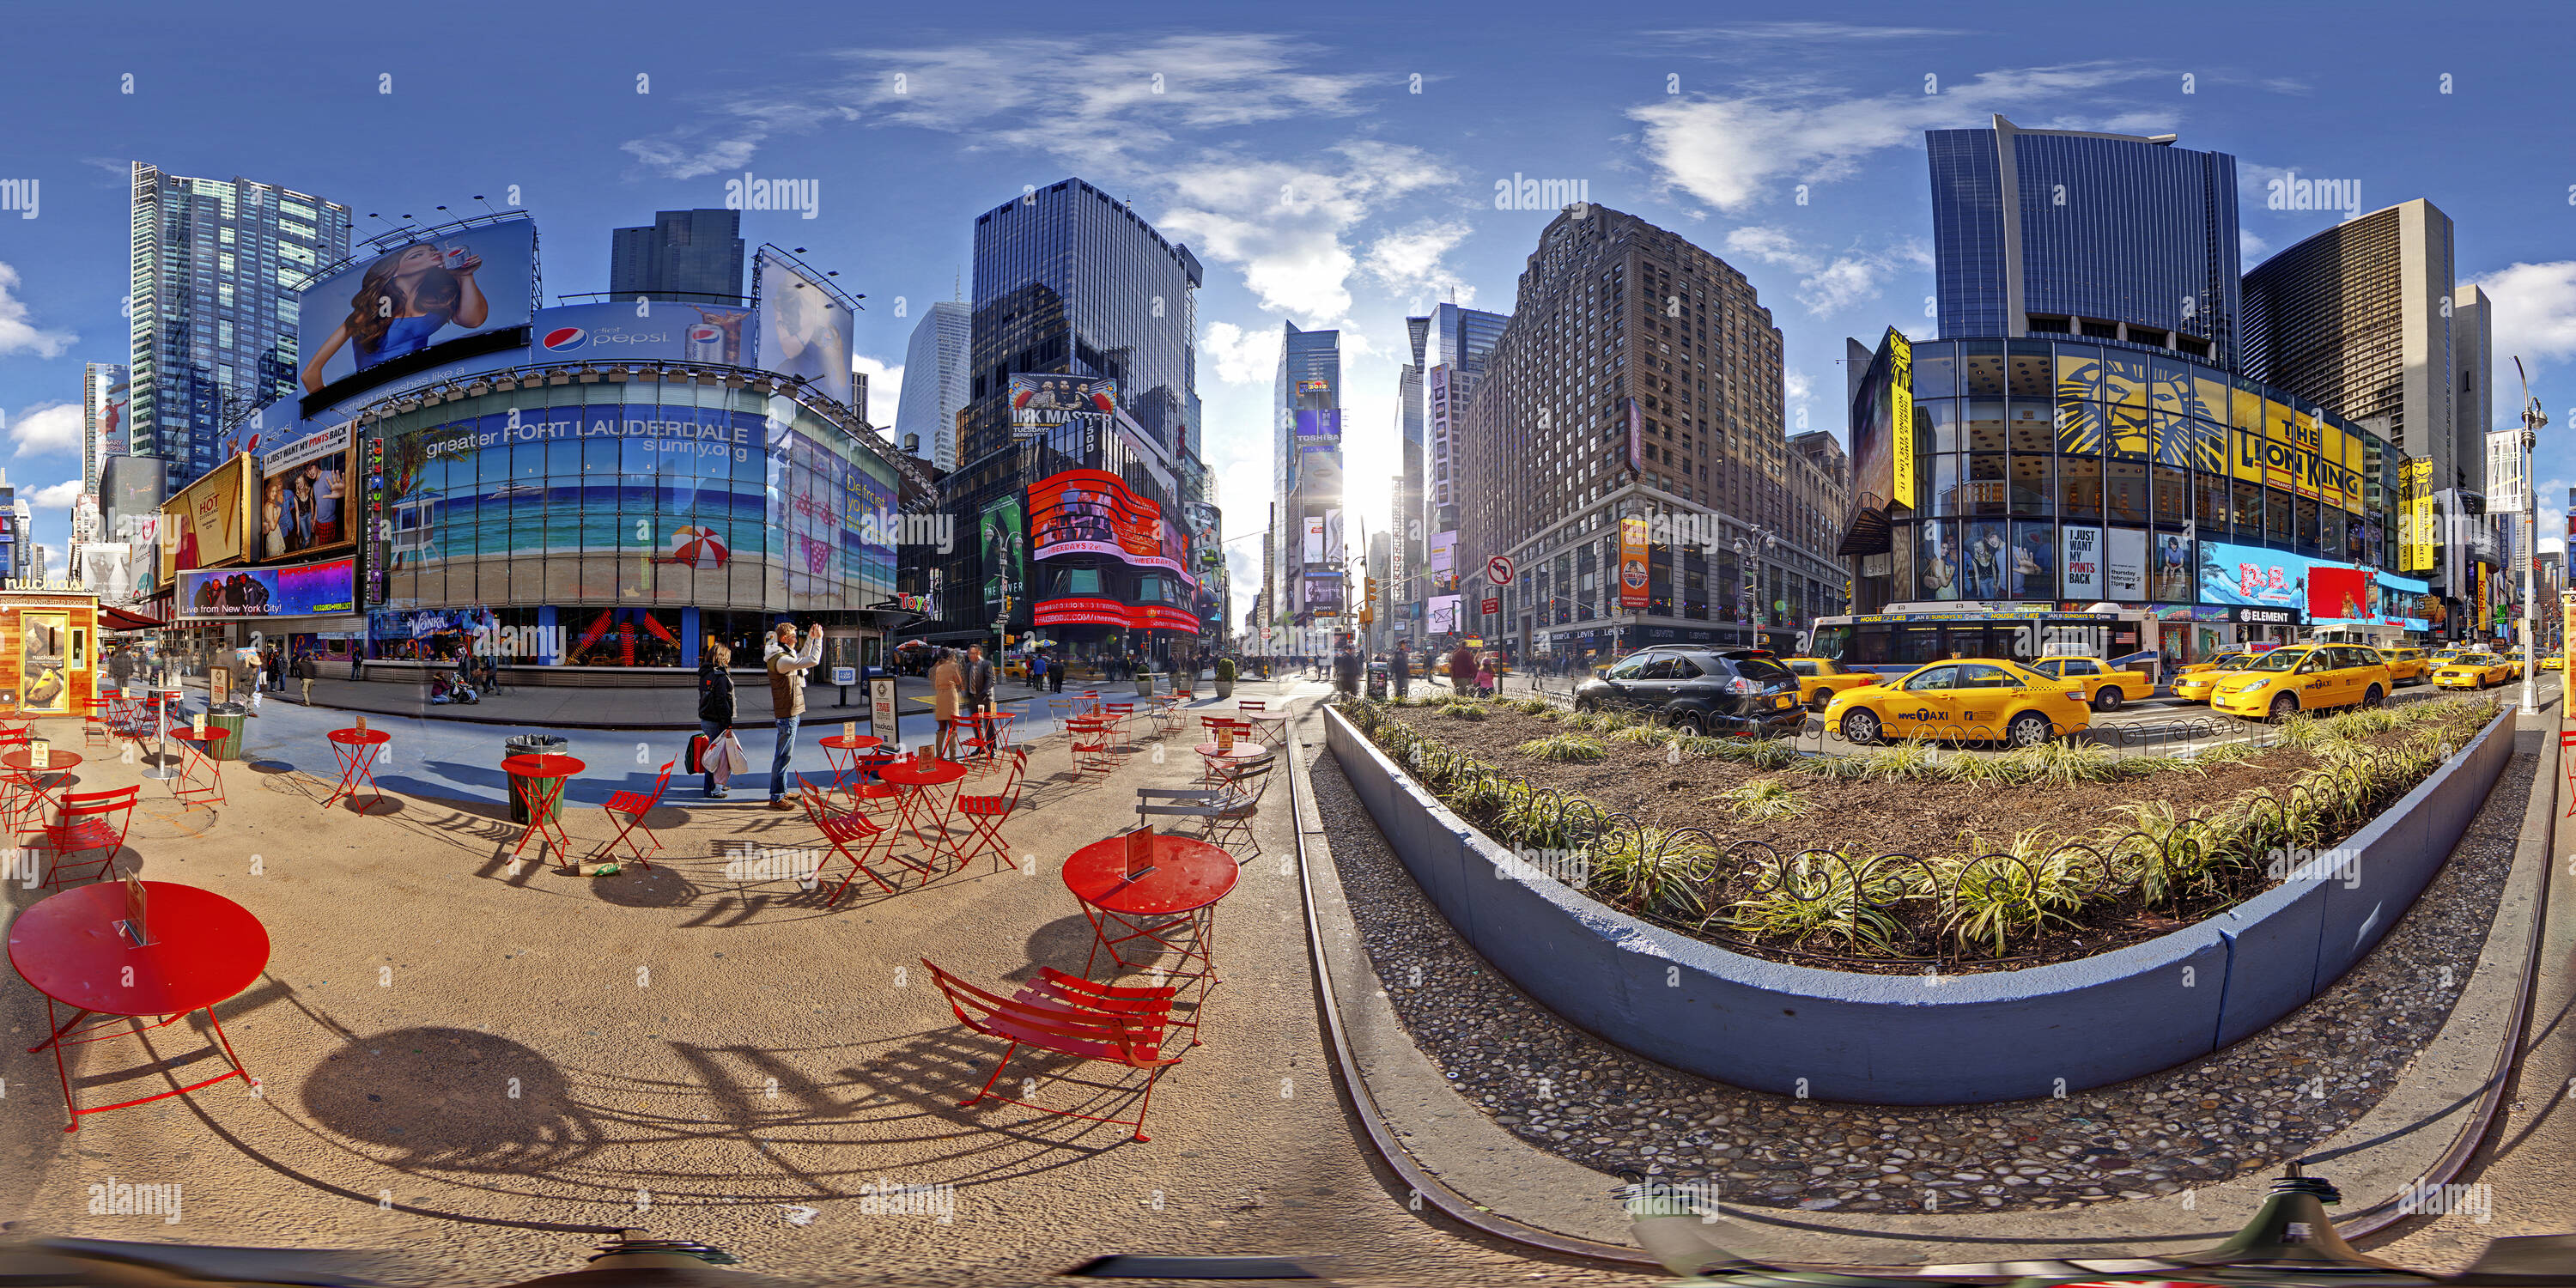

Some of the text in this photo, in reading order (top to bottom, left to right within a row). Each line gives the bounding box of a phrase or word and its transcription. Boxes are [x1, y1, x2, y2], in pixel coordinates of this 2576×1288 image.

[336, 393, 375, 417] nothing
[375, 377, 428, 402] refreshes
[432, 369, 453, 383] like
[1013, 410, 1042, 423] INK
[426, 419, 748, 459] greater FORT LAUDERDALE
[2281, 419, 2318, 447] THE
[270, 452, 283, 464] JUST
[283, 446, 298, 458] WANT
[300, 441, 309, 451] MY
[330, 425, 348, 440] BACK
[643, 440, 748, 462] sunny.org
[2240, 426, 2358, 495] LION KING
[2268, 478, 2293, 489] ENTRANCE
[847, 473, 885, 508] Defrost
[200, 494, 220, 515] HOT
[2074, 530, 2095, 541] JUST
[2069, 541, 2093, 552] WANT
[2069, 551, 2081, 562] MY
[2069, 562, 2095, 574] PANTS
[5, 573, 85, 592] nuchas
[2069, 574, 2090, 584] BACK
[984, 586, 996, 597] THE
[181, 604, 282, 614] Live from New York City!
[2252, 611, 2288, 623] ELEMENT
[1917, 708, 1948, 721] TAXI
